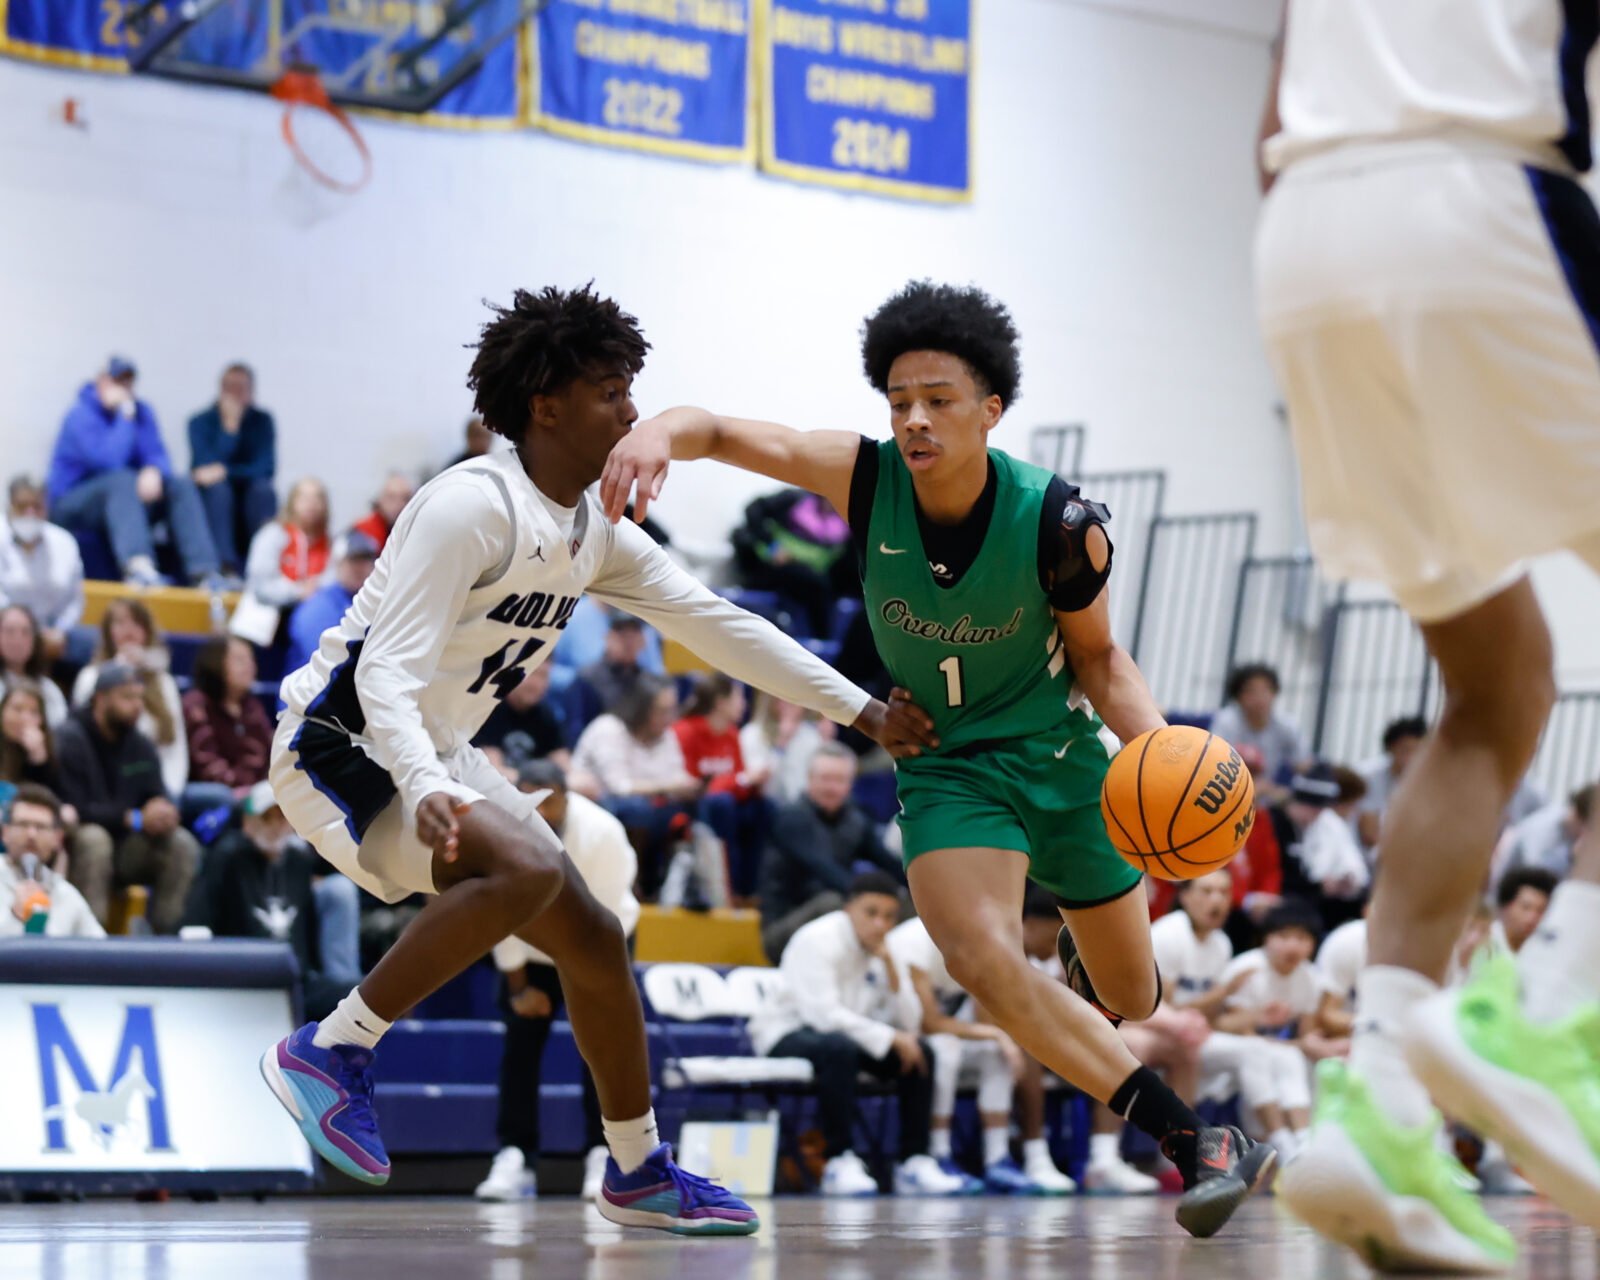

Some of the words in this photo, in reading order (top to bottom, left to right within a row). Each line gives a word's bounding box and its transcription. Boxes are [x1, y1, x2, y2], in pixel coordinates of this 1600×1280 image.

[575, 19, 711, 79] CHAMPIONS
[602, 78, 684, 136] 2022
[806, 64, 935, 121] CHAMPIONS
[832, 117, 911, 173] 2024
[881, 598, 1024, 646] Overland
[938, 655, 966, 709] 1
[1193, 746, 1243, 815] Wilso
[24, 999, 179, 1154] M
